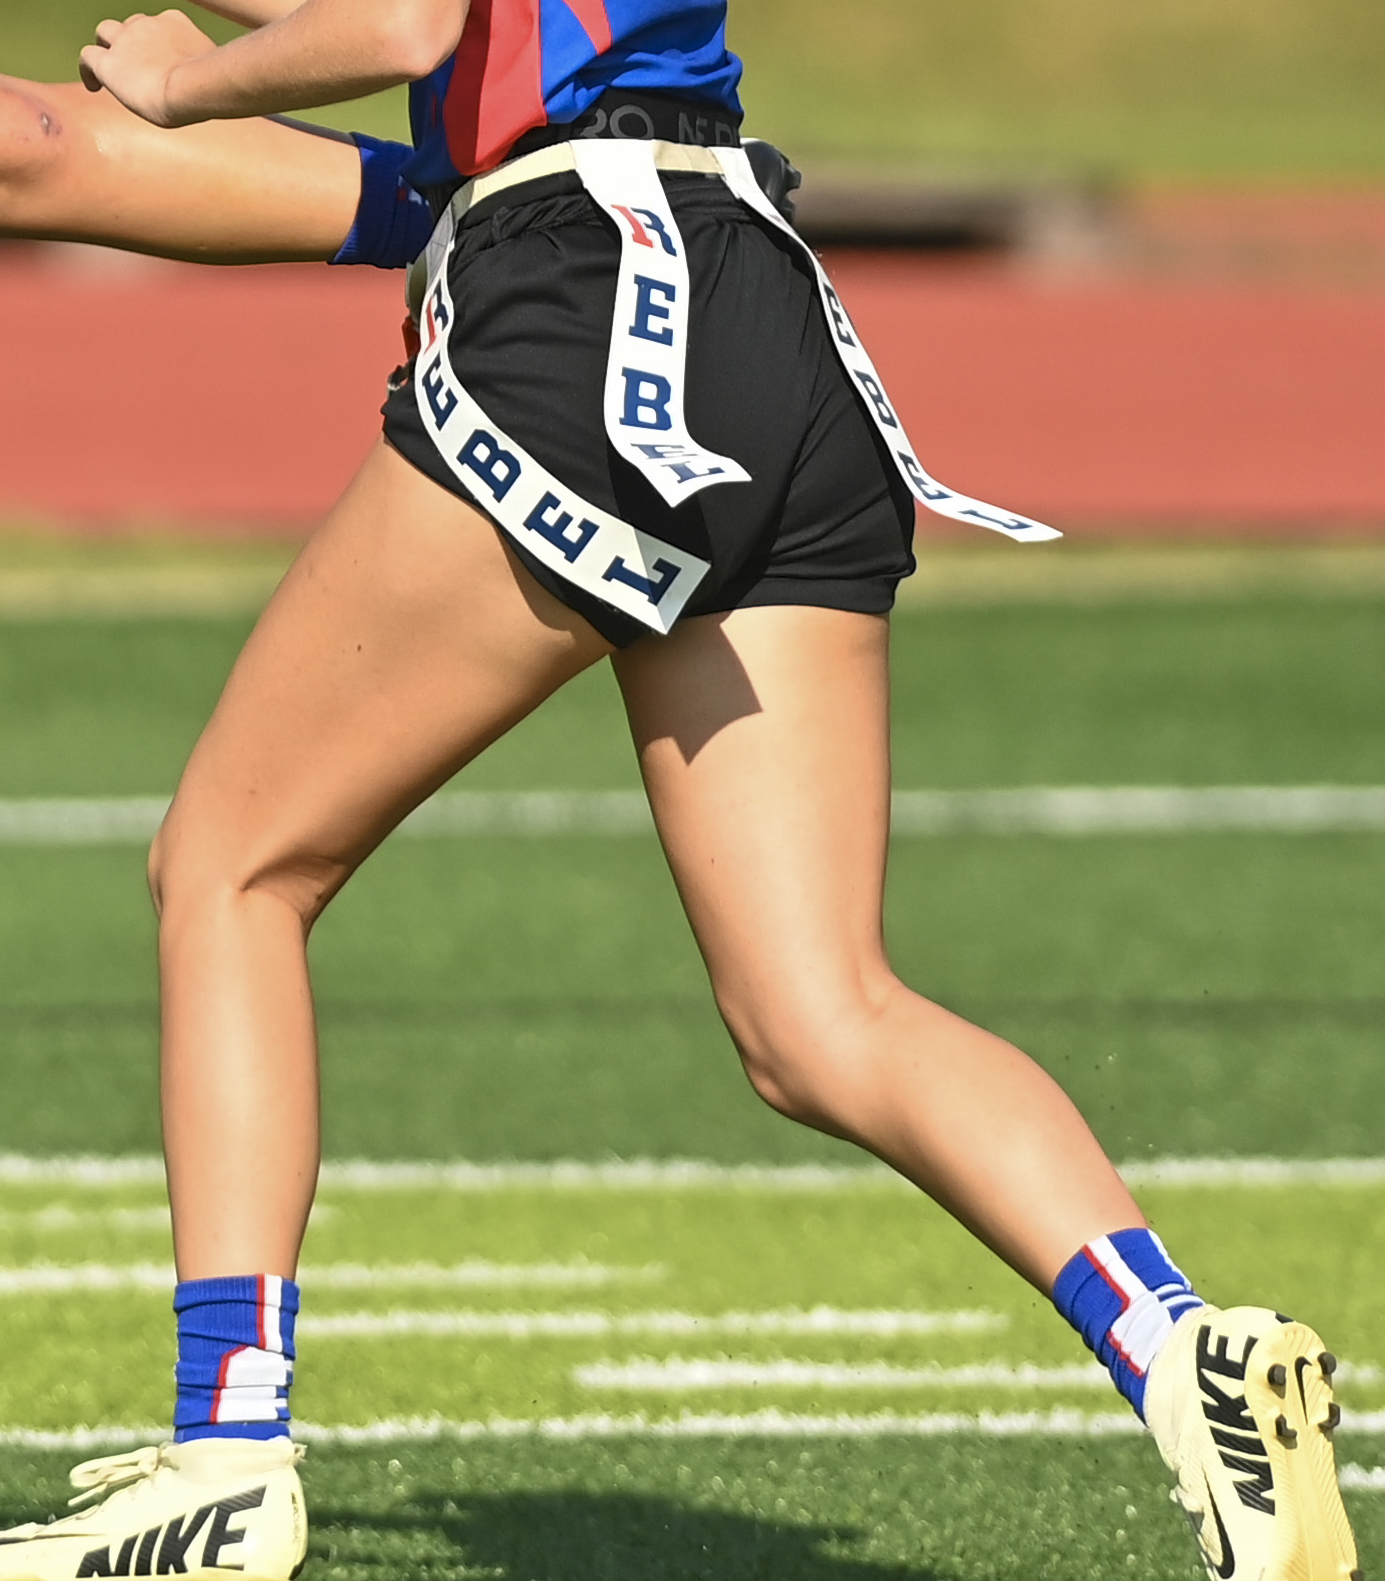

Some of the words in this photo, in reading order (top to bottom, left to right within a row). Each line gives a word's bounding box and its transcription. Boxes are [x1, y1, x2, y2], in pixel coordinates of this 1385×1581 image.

[422, 278, 683, 606] REBEL
[611, 204, 726, 484] REBEL
[75, 1484, 268, 1578] NIKE
[1195, 1324, 1276, 1516] NIKE
